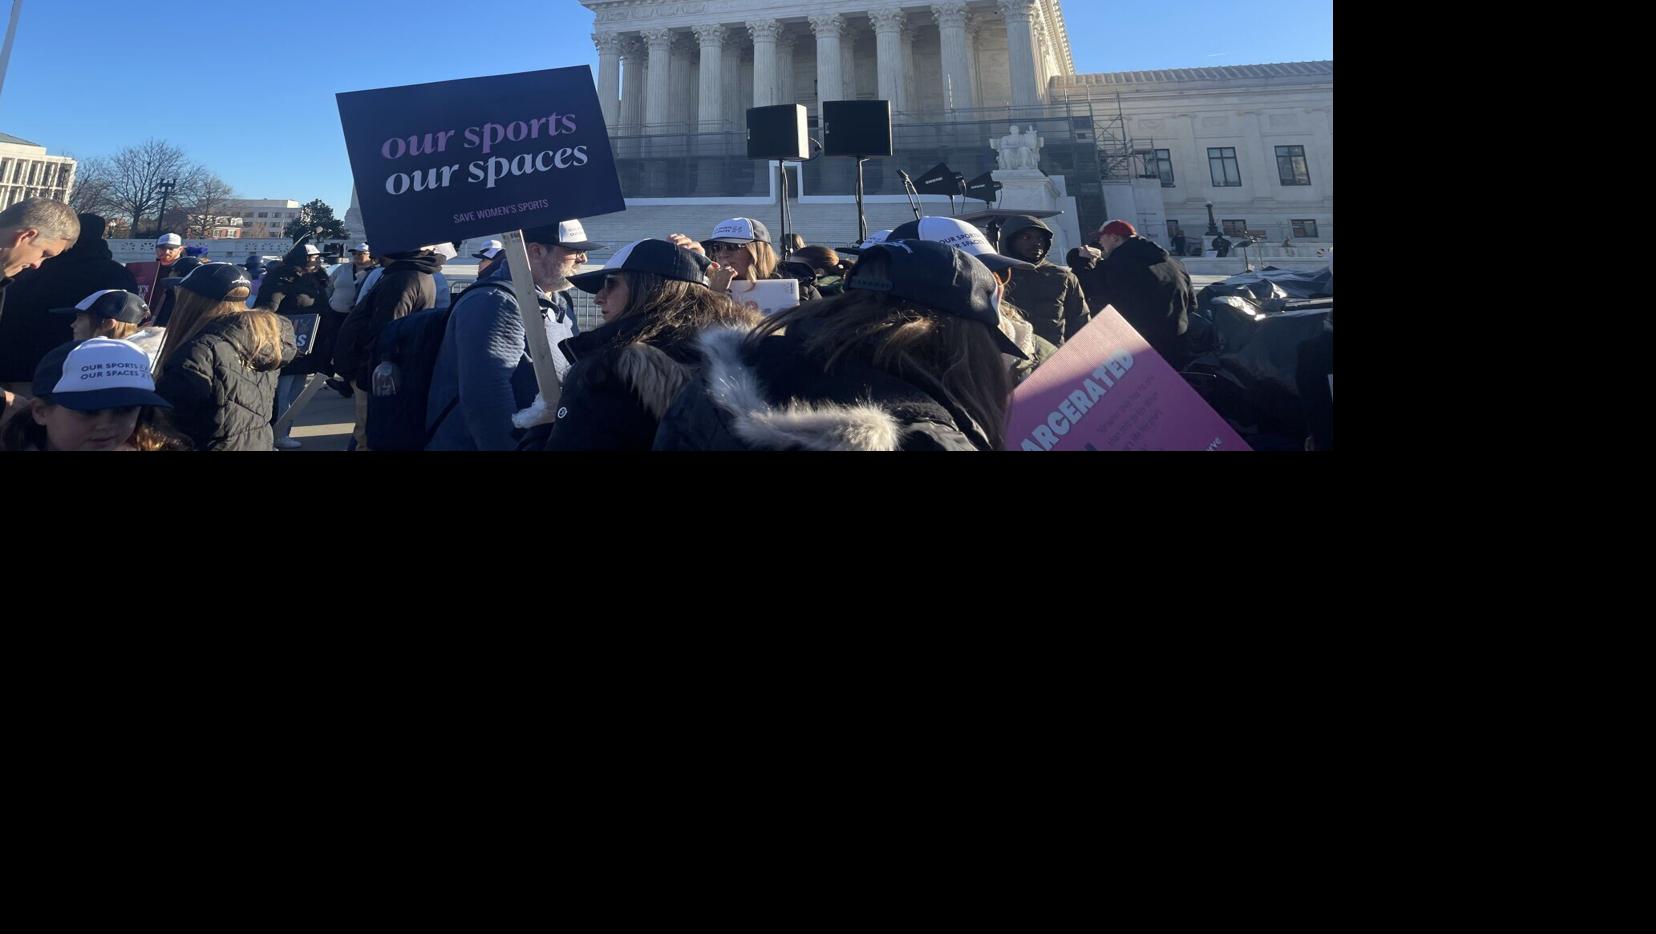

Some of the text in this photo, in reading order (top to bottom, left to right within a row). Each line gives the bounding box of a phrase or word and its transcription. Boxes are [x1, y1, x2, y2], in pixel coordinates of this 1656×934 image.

[381, 112, 577, 160] our sports
[385, 145, 588, 195] our spaces
[453, 199, 549, 224] SAVE WOMEN'S SPORTS
[80, 363, 103, 372] OUR
[80, 371, 103, 380] OUR
